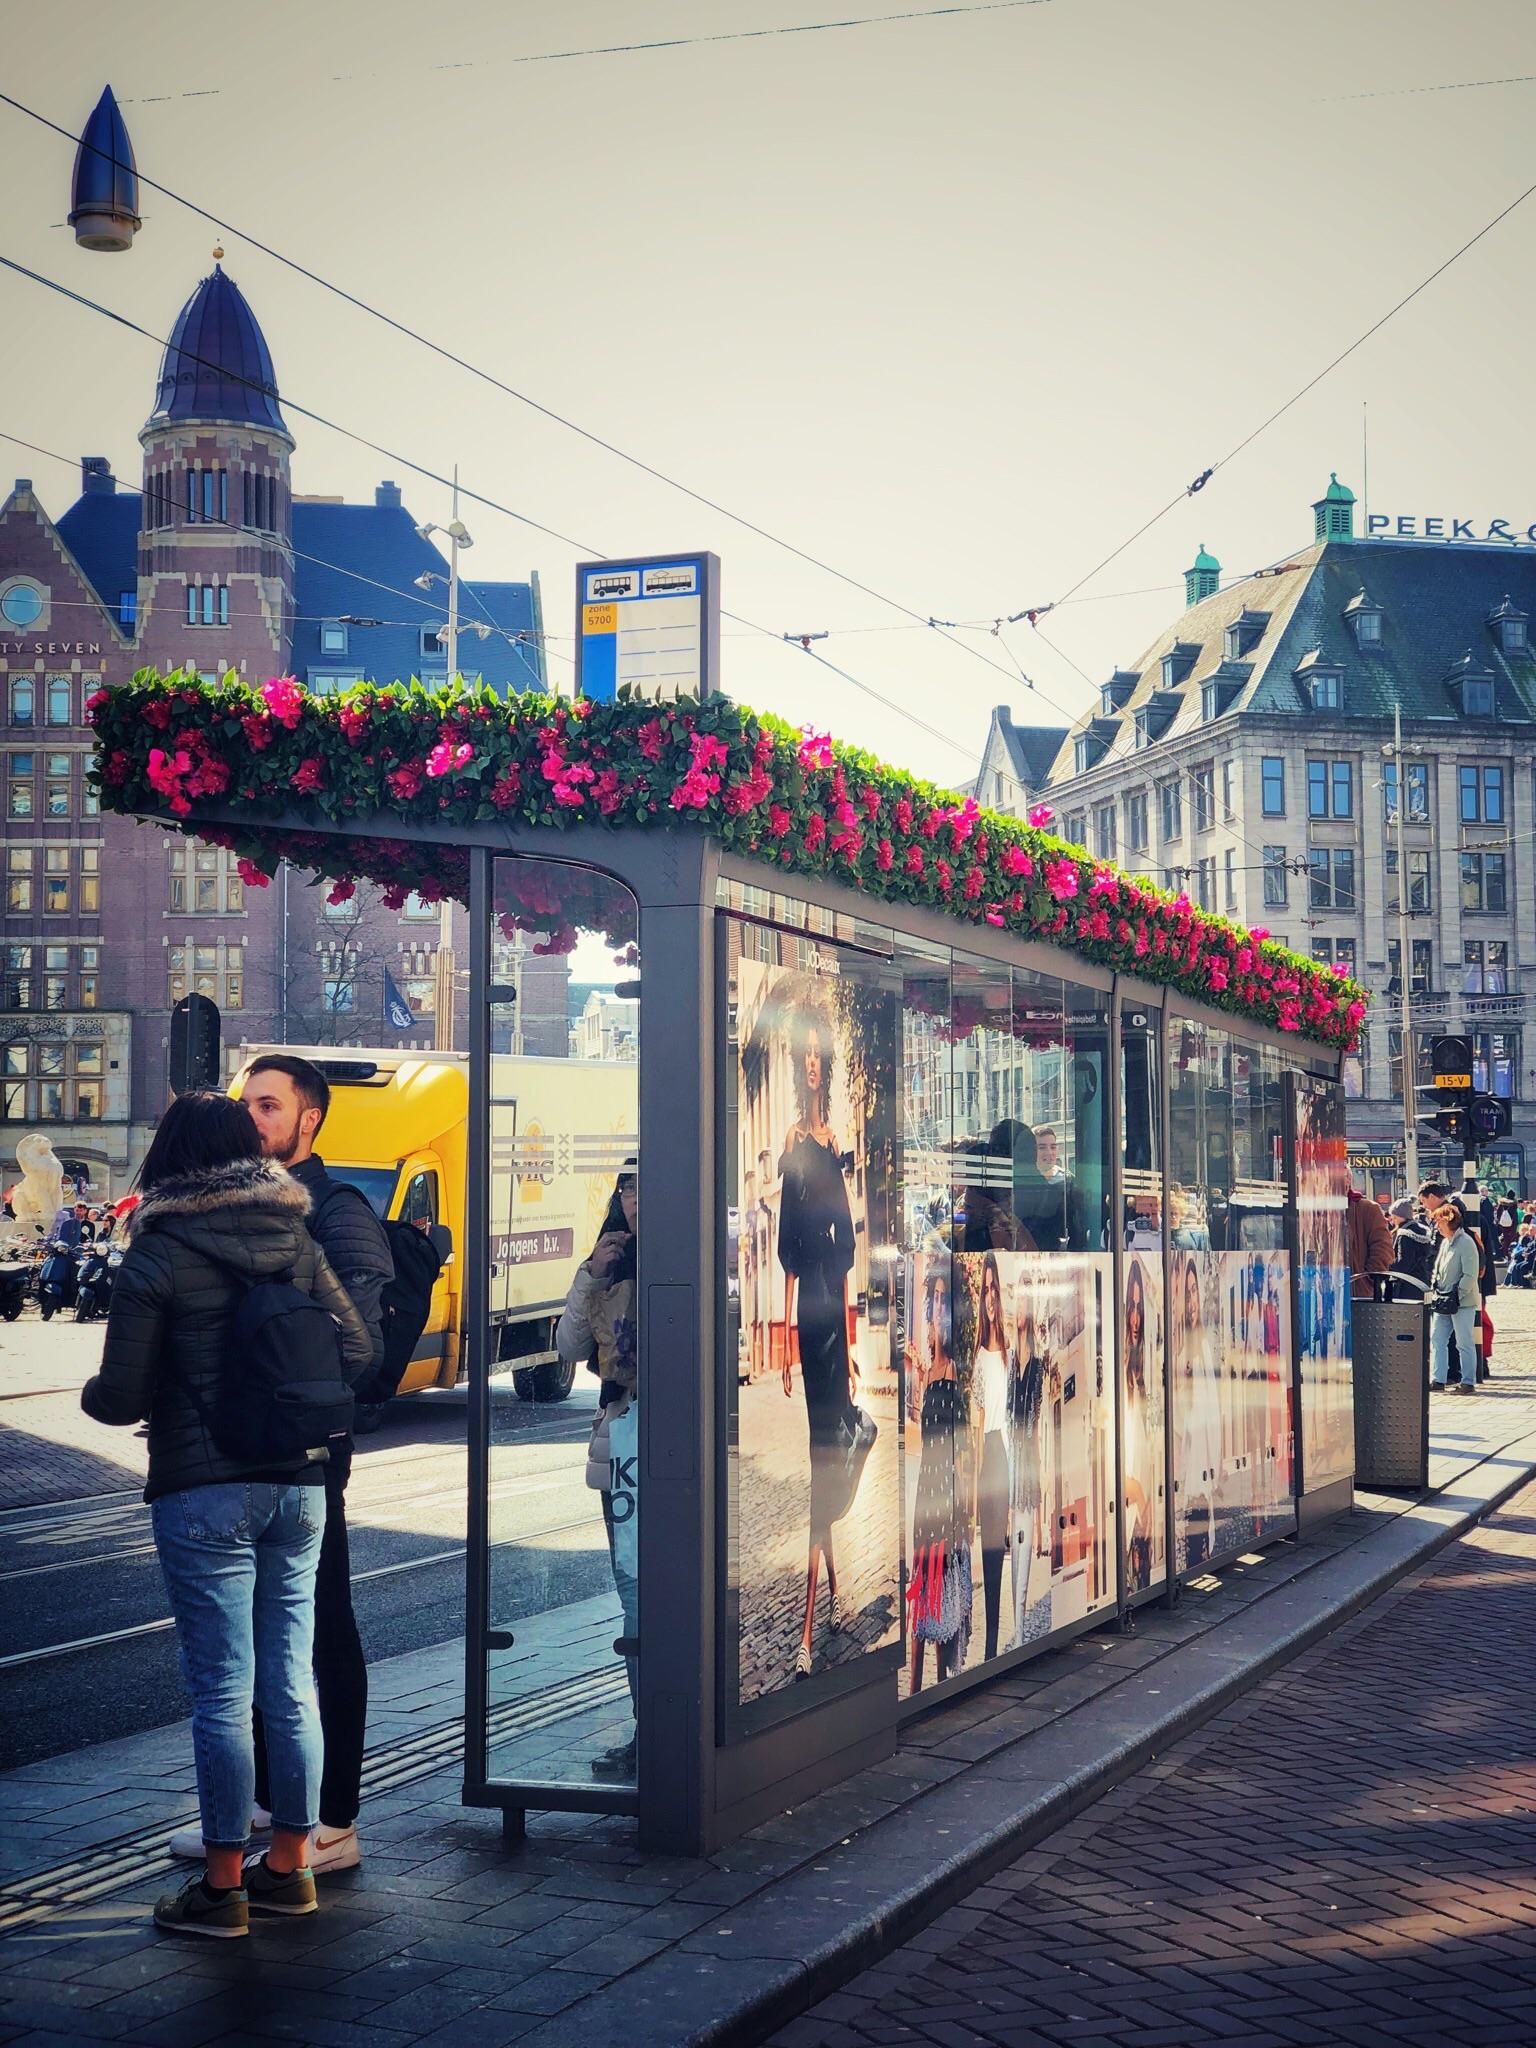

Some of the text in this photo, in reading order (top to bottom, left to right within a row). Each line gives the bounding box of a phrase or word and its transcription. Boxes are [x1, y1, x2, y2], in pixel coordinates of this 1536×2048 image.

[588, 605, 611, 613] zone
[588, 615, 612, 626] 5700
[0, 642, 101, 654] TY SEVEN
[1442, 1076, 1465, 1086] 15-V
[496, 1233, 560, 1263] Jongens b.v.
